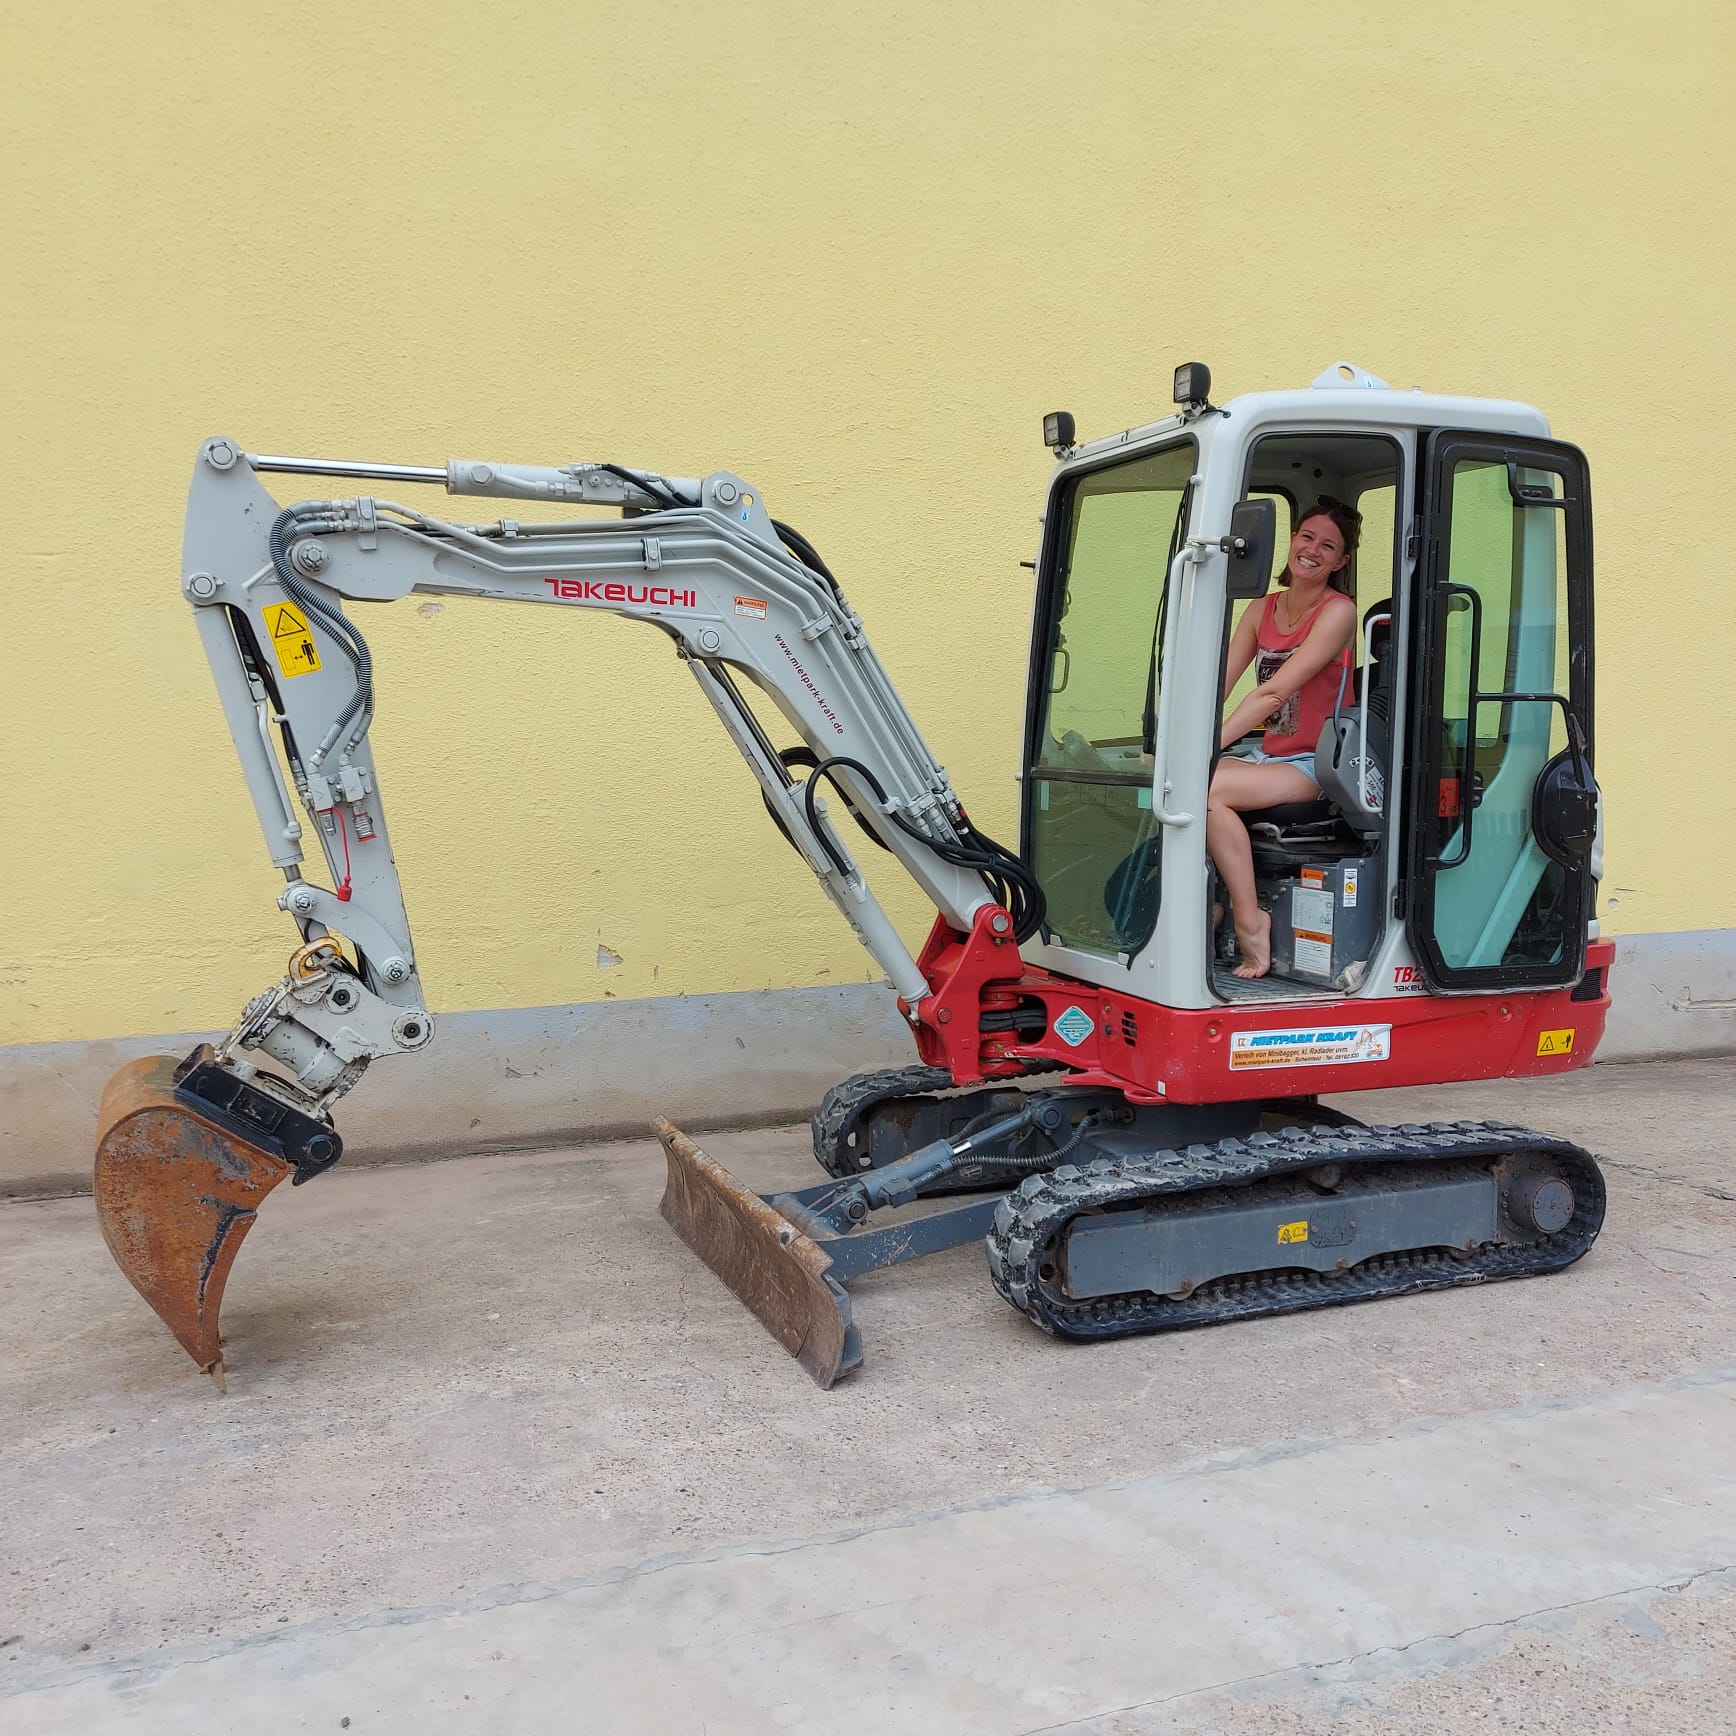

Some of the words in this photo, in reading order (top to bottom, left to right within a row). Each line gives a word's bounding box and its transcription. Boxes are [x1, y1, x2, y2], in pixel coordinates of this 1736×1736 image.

[544, 578, 696, 607] TAKEUCHI
[774, 633, 844, 734] www.mietpark-kraft.de
[1393, 966, 1422, 983] TB2
[1393, 984, 1425, 992] TAKEU
[1250, 1033, 1315, 1046] MIETPARK
[1316, 1031, 1358, 1042] KRAFT
